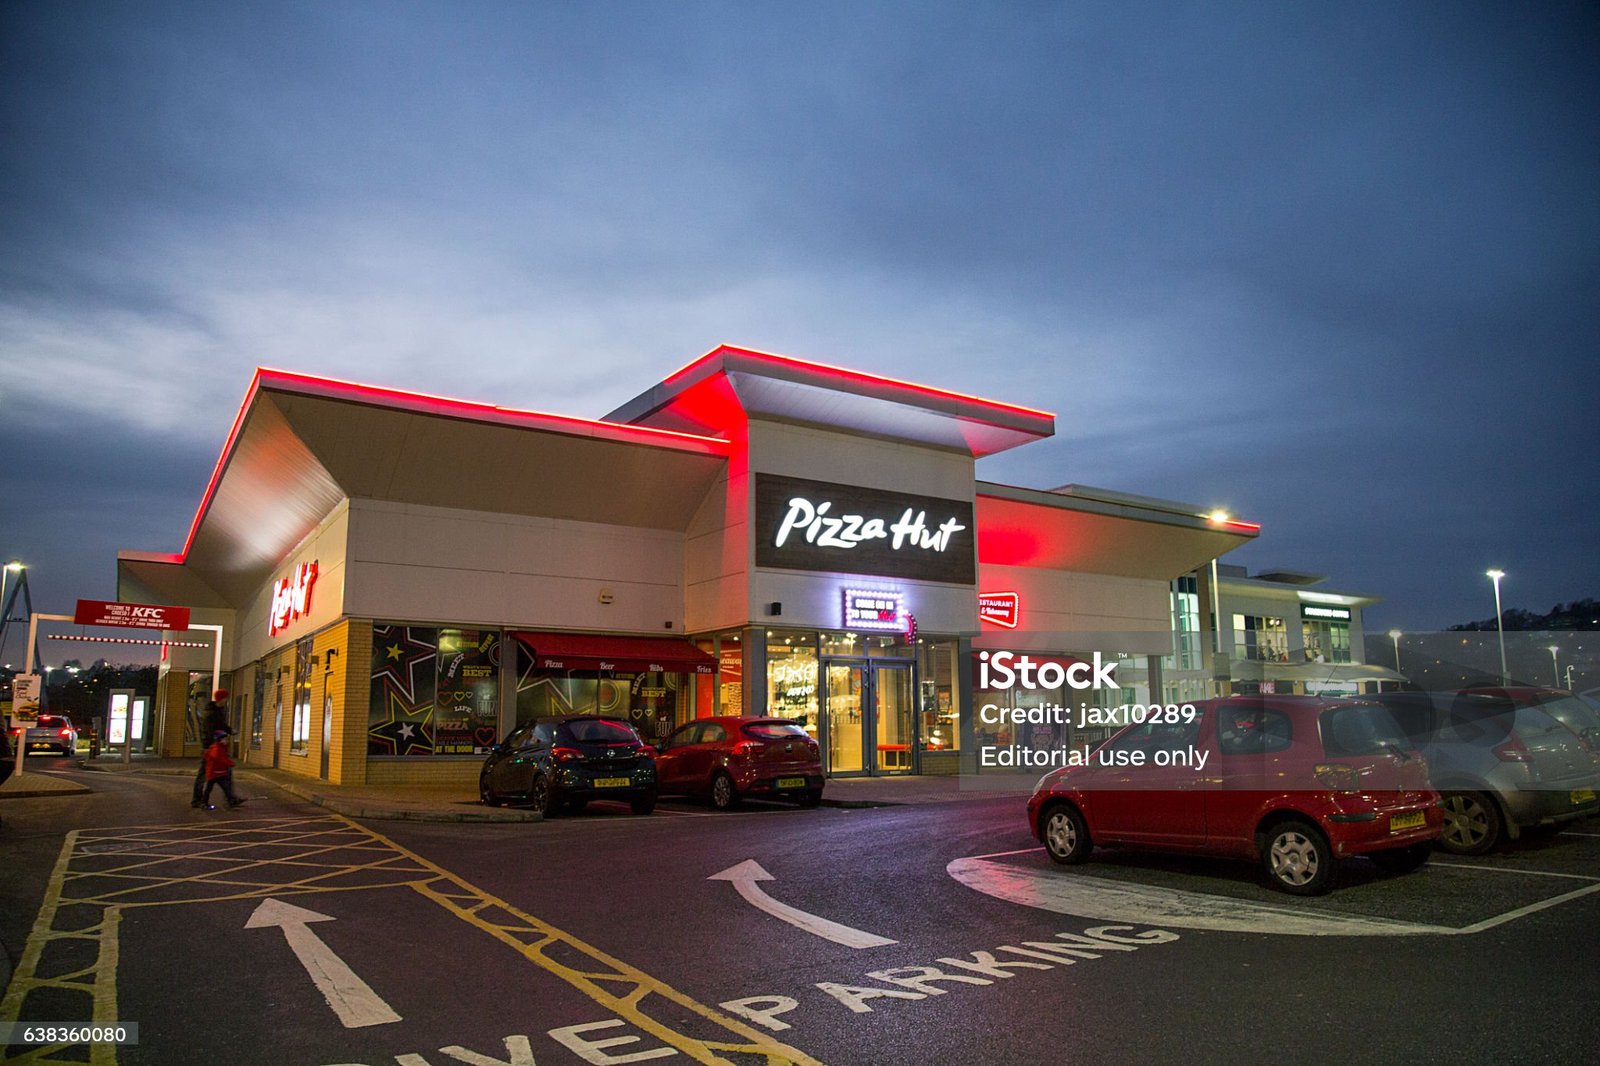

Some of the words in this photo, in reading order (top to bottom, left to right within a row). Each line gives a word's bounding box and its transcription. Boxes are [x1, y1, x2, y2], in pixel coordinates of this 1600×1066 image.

[775, 497, 887, 549] Pizza
[890, 508, 966, 552] Hut
[131, 607, 165, 619] KFC
[545, 659, 563, 668] Pizza
[600, 661, 615, 670] Beer
[462, 669, 492, 677] BEST
[454, 705, 473, 713] LIFE
[436, 721, 469, 730] PIZZA
